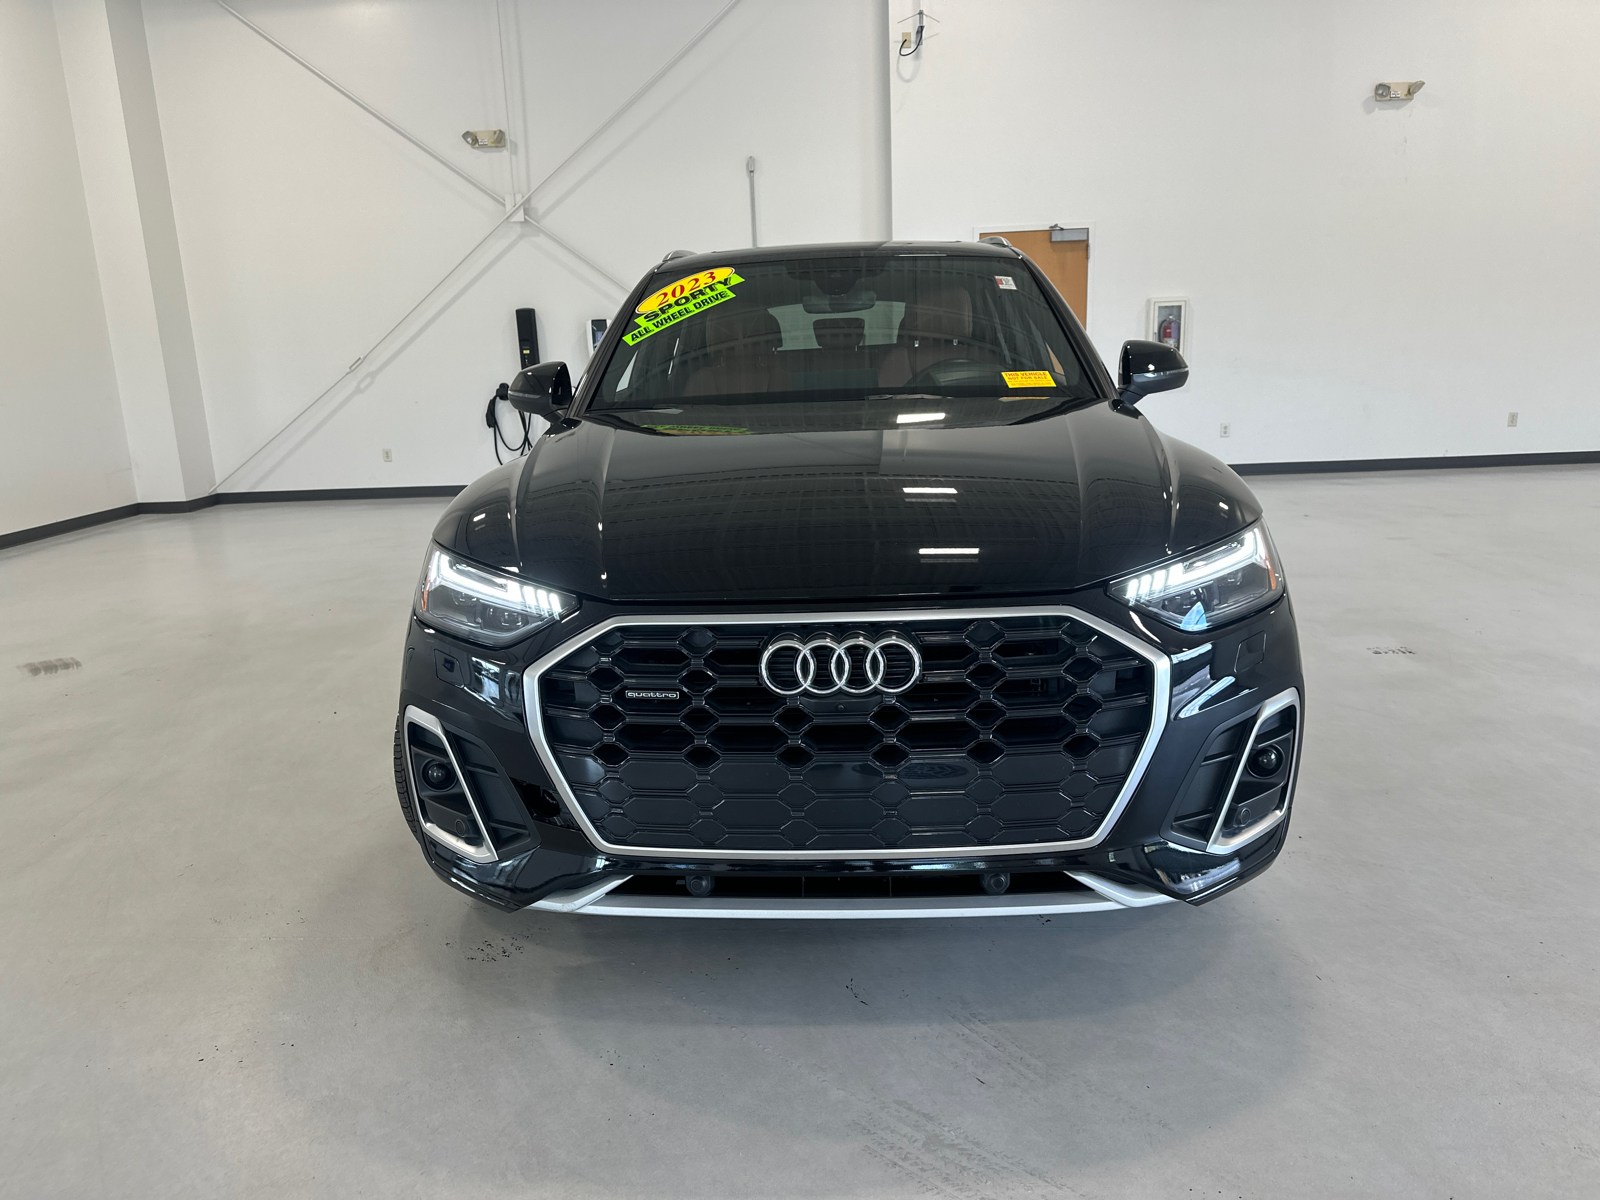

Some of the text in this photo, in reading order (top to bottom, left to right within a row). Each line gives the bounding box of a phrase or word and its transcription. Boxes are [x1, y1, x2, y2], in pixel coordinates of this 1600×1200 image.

[643, 277, 732, 322] SPORTY
[656, 271, 716, 307] 2023
[631, 290, 728, 341] ALL WHEEL DRIVE
